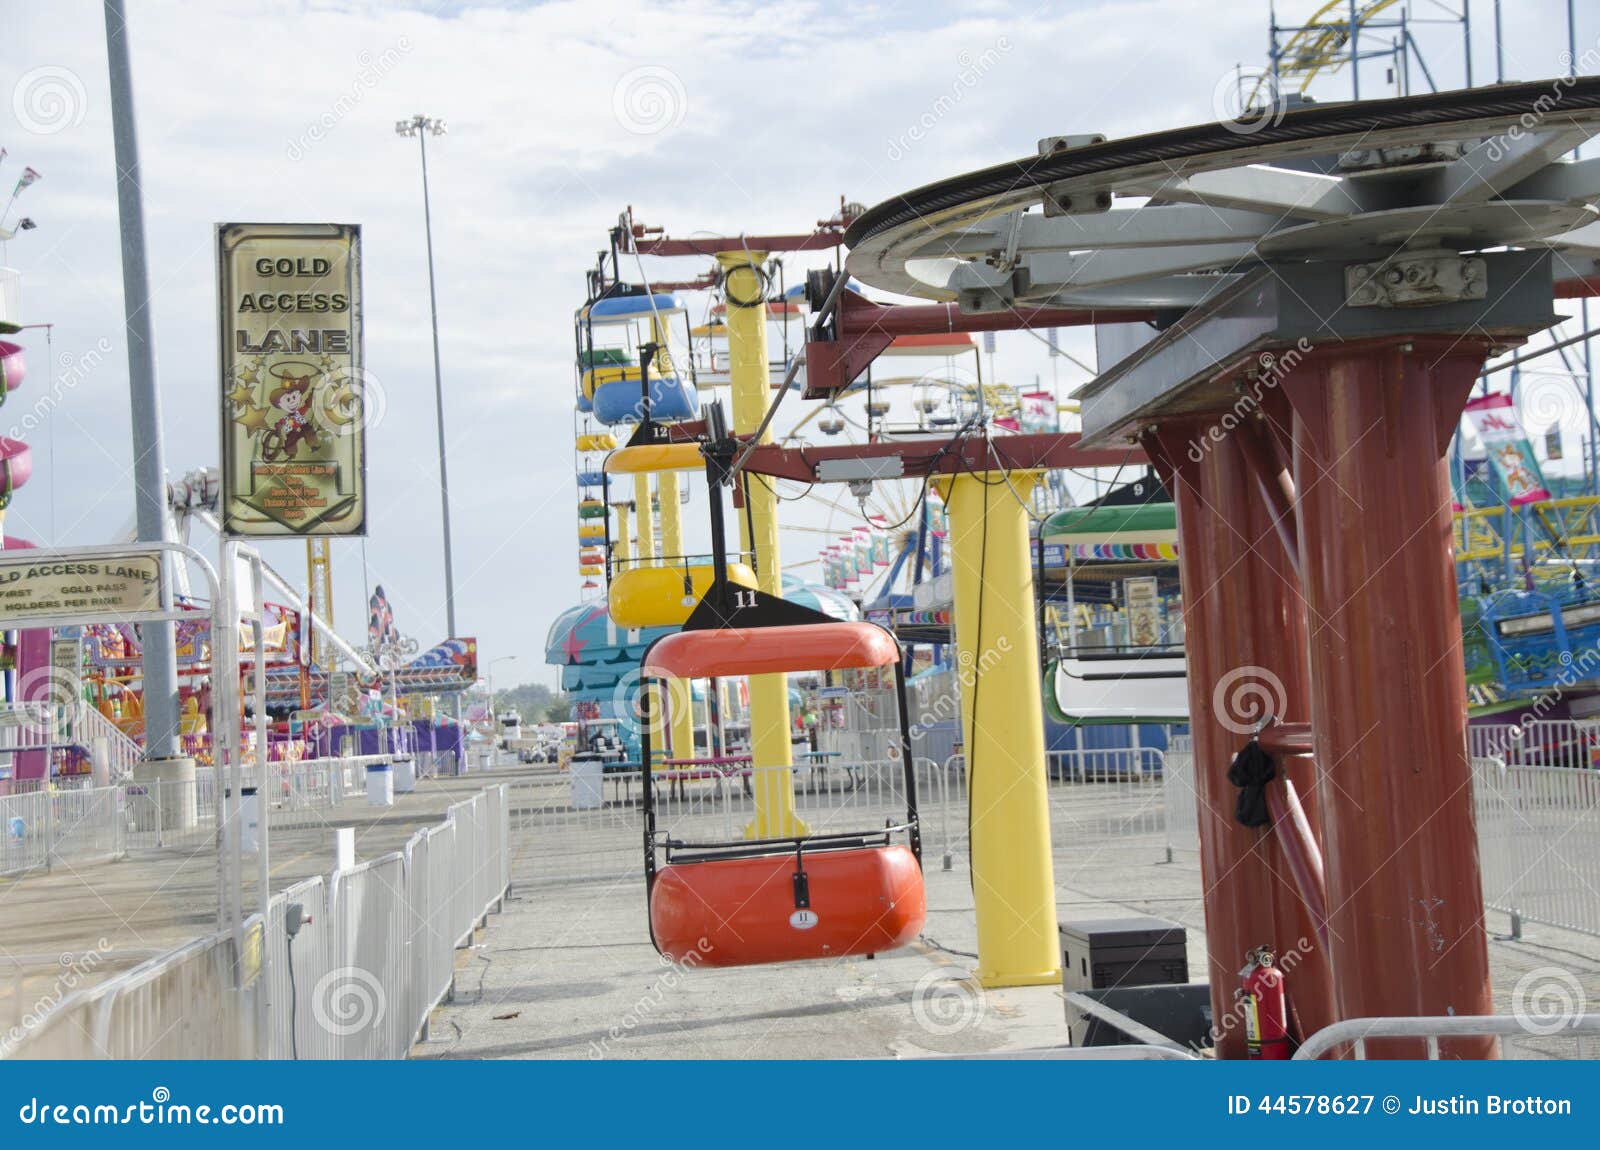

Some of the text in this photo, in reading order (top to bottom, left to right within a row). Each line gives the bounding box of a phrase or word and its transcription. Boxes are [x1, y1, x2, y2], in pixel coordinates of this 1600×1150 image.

[255, 258, 332, 277] GOLD
[238, 293, 350, 313] ACCESS
[236, 329, 350, 355] LANE
[653, 427, 668, 437] 12
[1133, 483, 1144, 496] 9
[27, 564, 99, 579] ACCESS
[105, 565, 152, 581] LANE
[60, 586, 93, 594] GOLD
[96, 583, 128, 592] PASS
[5, 600, 61, 611] HOLDERS
[64, 599, 87, 607] PER
[734, 590, 759, 608] 11
